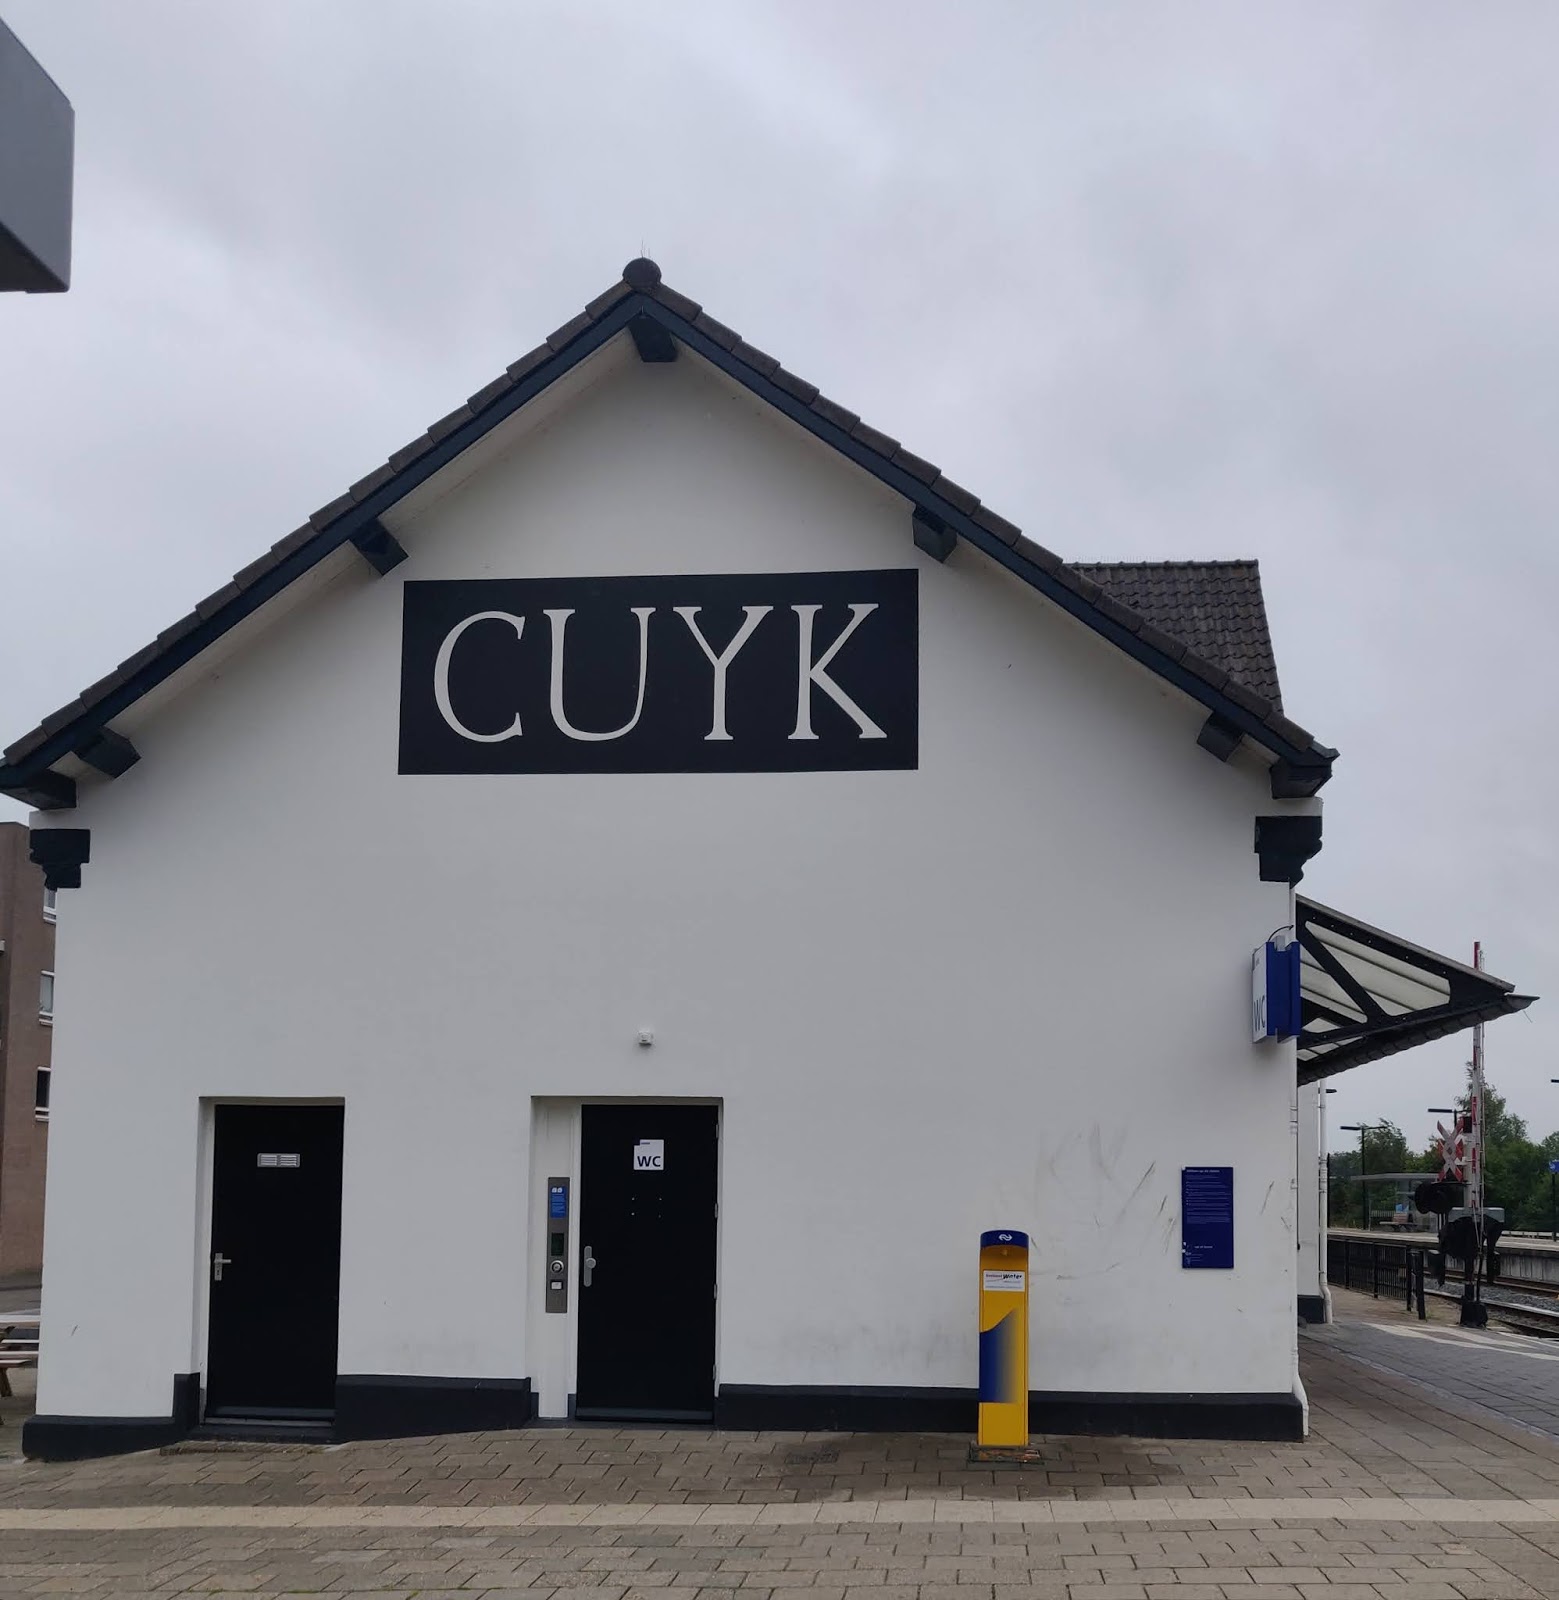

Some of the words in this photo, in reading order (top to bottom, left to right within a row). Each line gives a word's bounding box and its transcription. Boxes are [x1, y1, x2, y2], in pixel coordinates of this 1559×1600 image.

[433, 603, 889, 743] CUYK
[1254, 995, 1266, 1032] WC
[637, 1155, 661, 1167] WC
